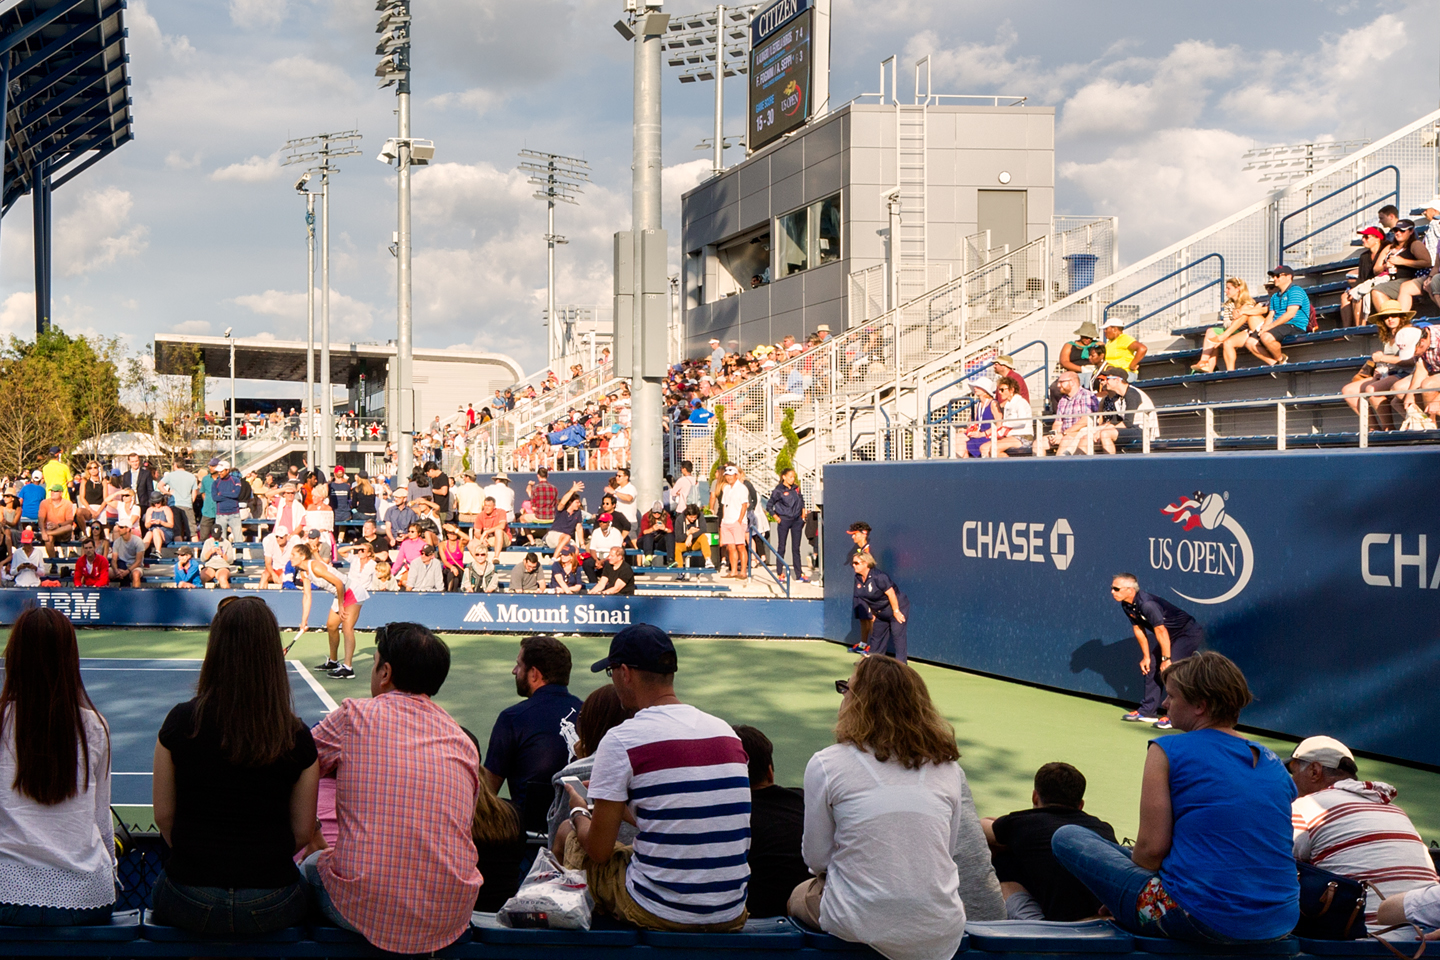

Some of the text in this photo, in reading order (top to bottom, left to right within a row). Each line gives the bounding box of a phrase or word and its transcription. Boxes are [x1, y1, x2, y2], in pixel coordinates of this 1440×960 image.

[962, 520, 1046, 563] CHASE
[1148, 537, 1238, 577] US OPEN
[1361, 532, 1440, 590] CH
[37, 592, 101, 620] IBM
[496, 603, 632, 625] Mount Sinai
